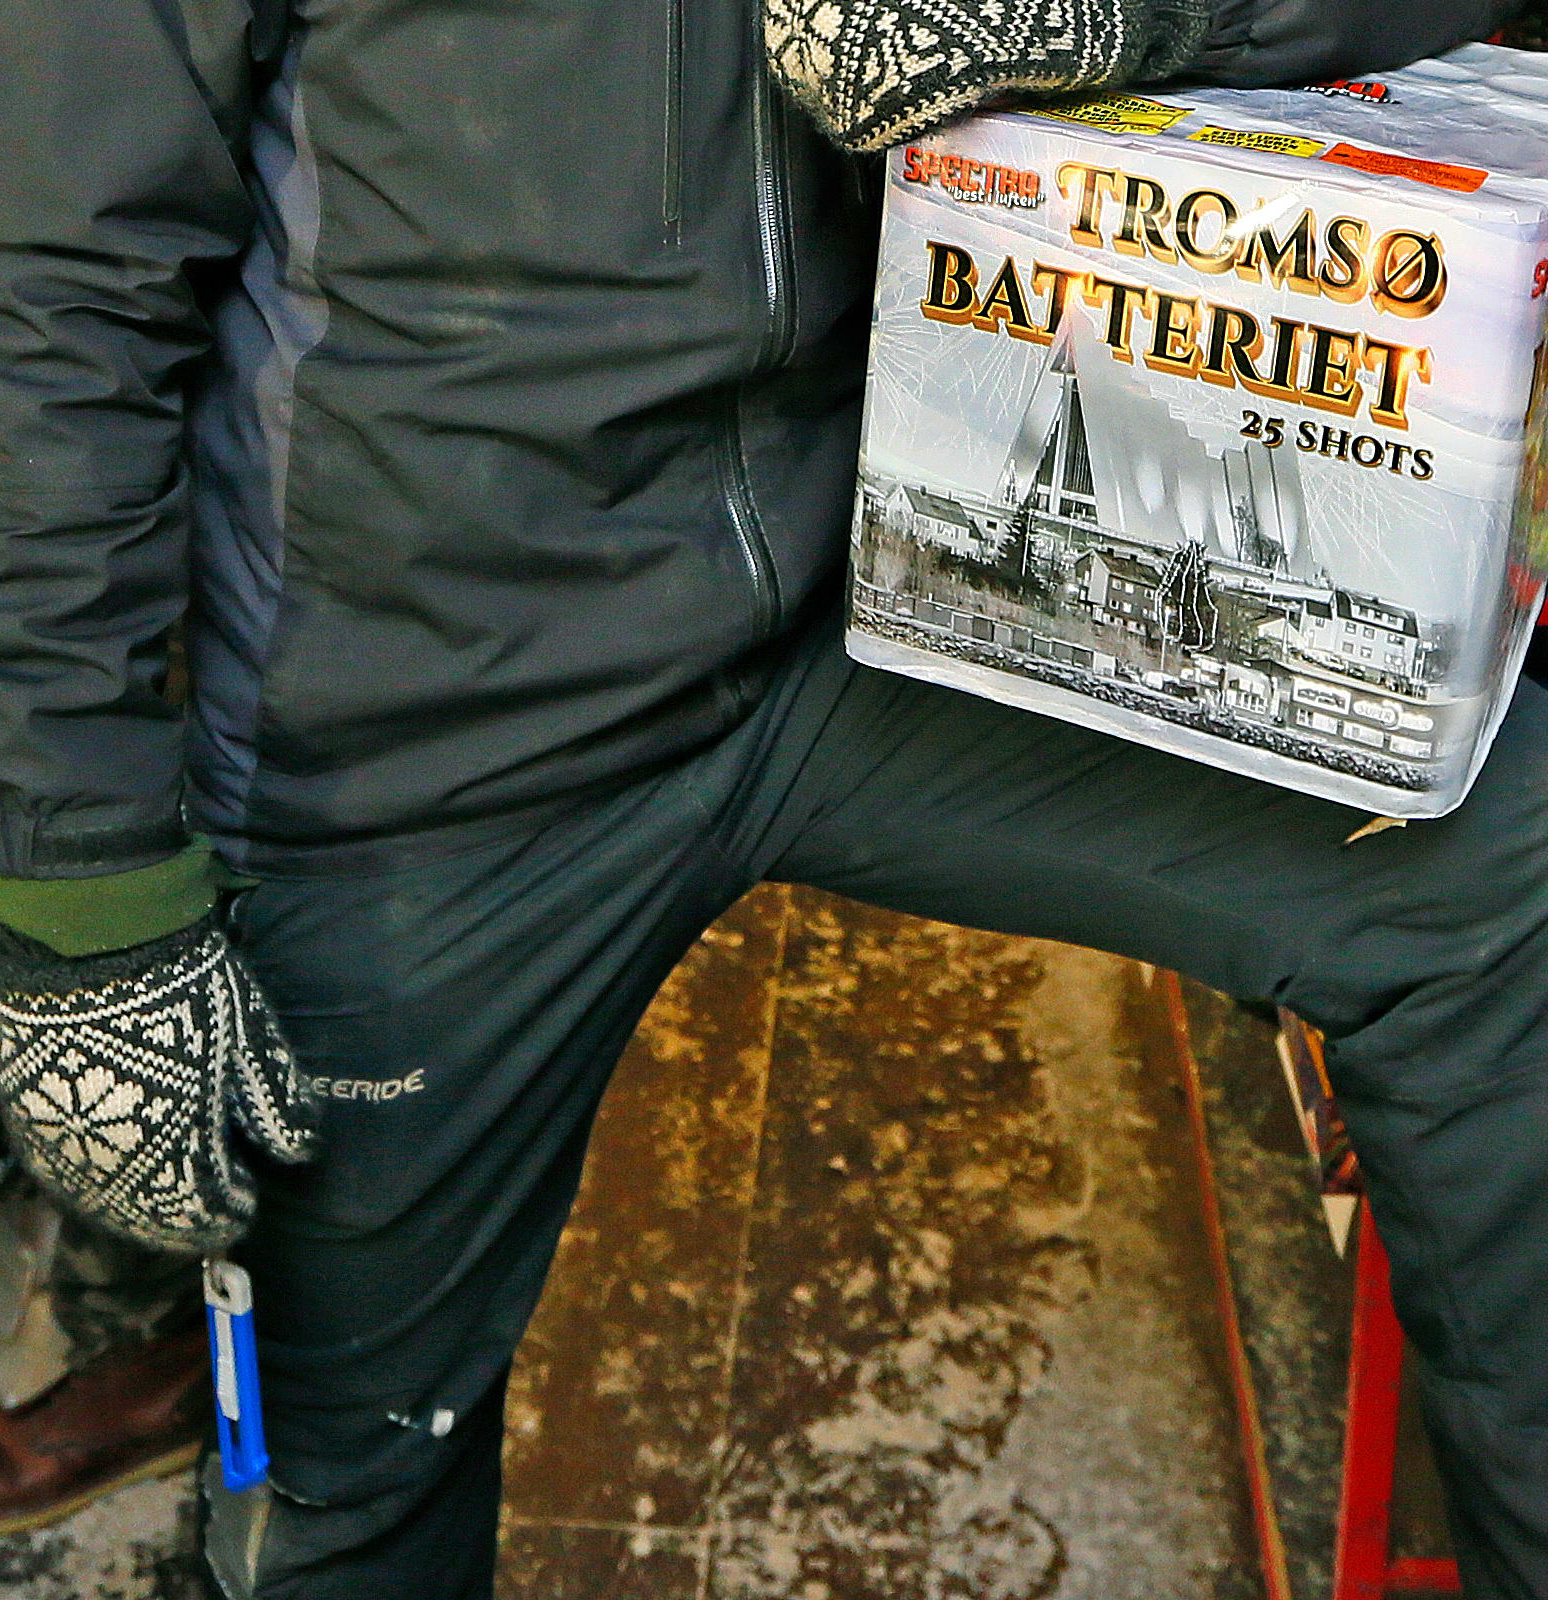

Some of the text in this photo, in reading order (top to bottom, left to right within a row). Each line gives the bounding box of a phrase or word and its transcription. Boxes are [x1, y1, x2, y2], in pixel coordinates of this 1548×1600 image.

[903, 146, 1040, 200] SPECTRA
[1056, 159, 1448, 319] TROMSØ
[921, 238, 1436, 431] BATTERIET
[1238, 409, 1436, 481] 25 SHOTS
